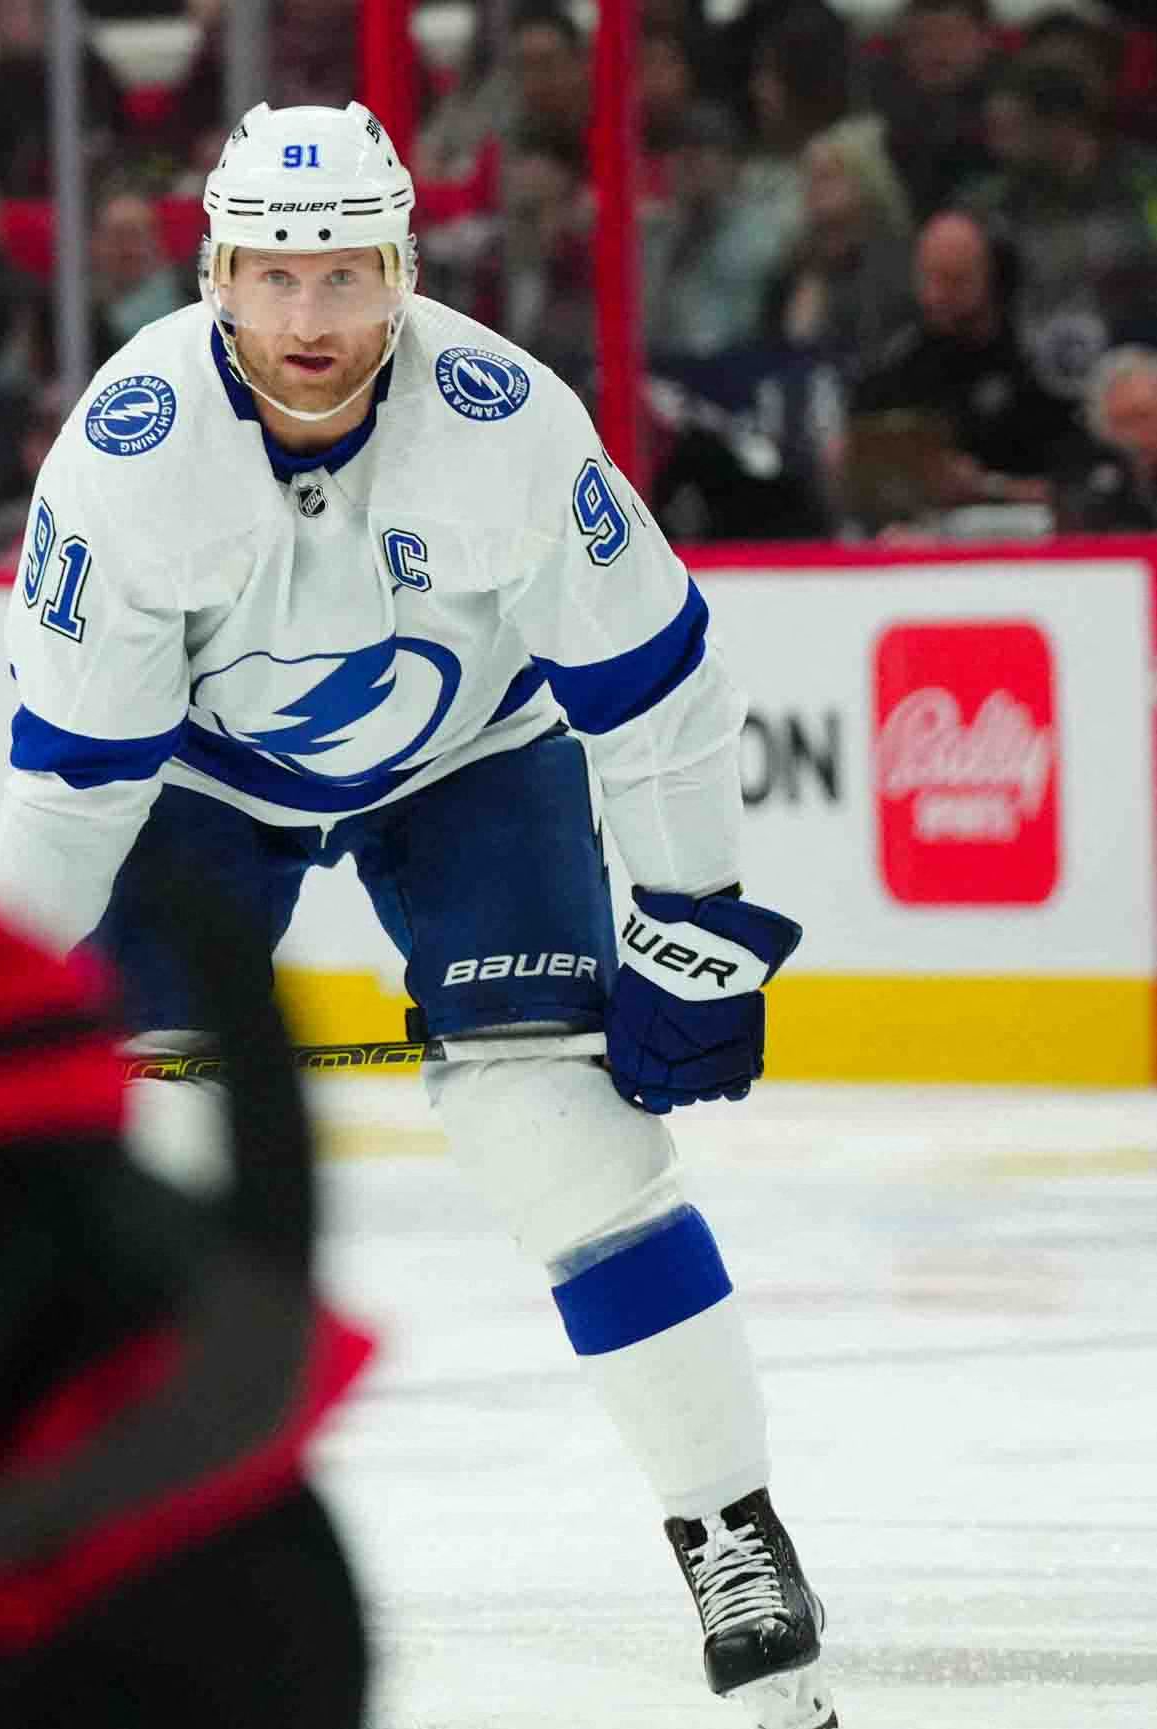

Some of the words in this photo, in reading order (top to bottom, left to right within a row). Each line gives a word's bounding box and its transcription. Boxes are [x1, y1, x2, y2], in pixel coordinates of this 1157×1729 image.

[282, 143, 321, 169] 91
[267, 201, 338, 213] BAUER
[93, 378, 137, 409] TAMPA
[141, 376, 167, 392] BAY
[439, 367, 455, 395] BAY
[452, 395, 503, 417] TAMPA
[119, 392, 173, 453] LIGHTNING
[572, 450, 646, 567] 9
[23, 496, 92, 643] 91
[382, 528, 432, 593] C
[622, 913, 739, 989] UER
[442, 952, 597, 986] BAUER
